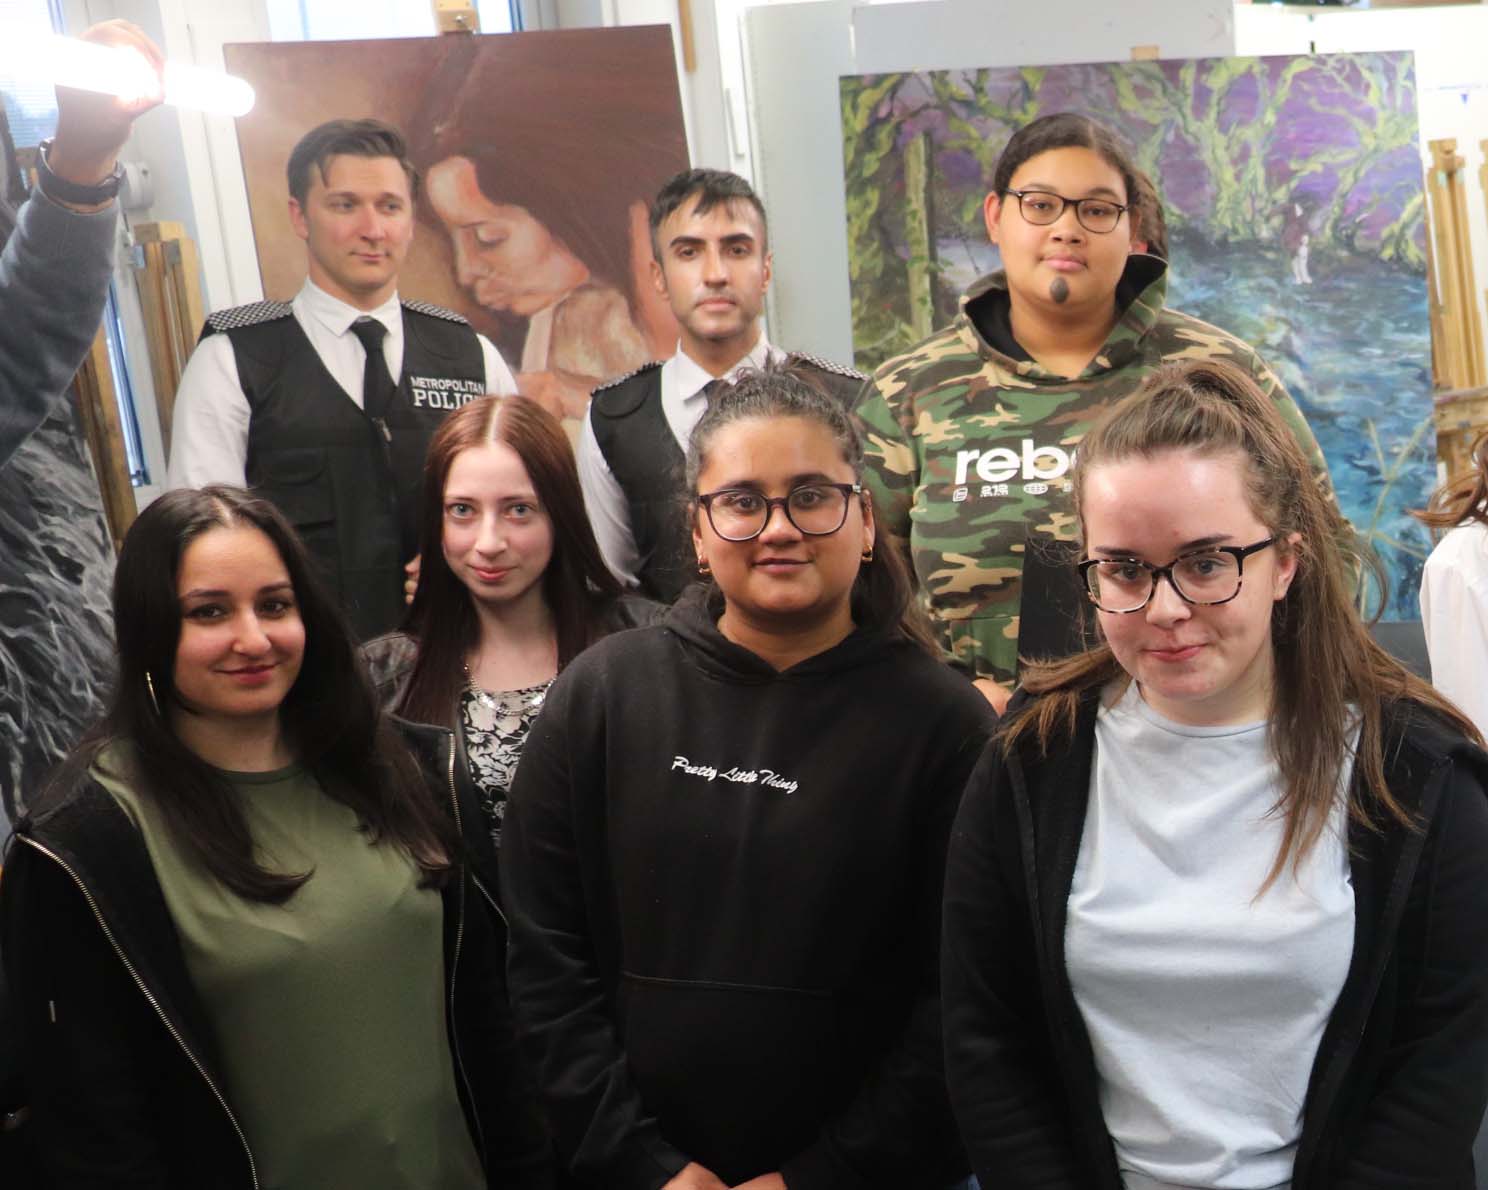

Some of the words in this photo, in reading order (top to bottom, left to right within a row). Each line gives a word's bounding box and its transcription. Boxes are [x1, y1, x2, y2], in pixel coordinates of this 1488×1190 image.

[410, 376, 485, 394] METROPOLITAN
[412, 388, 479, 410] POLIC
[955, 438, 1080, 485] reb
[671, 755, 718, 782] Pretty
[719, 767, 758, 783] Little
[759, 769, 799, 794] Thing
